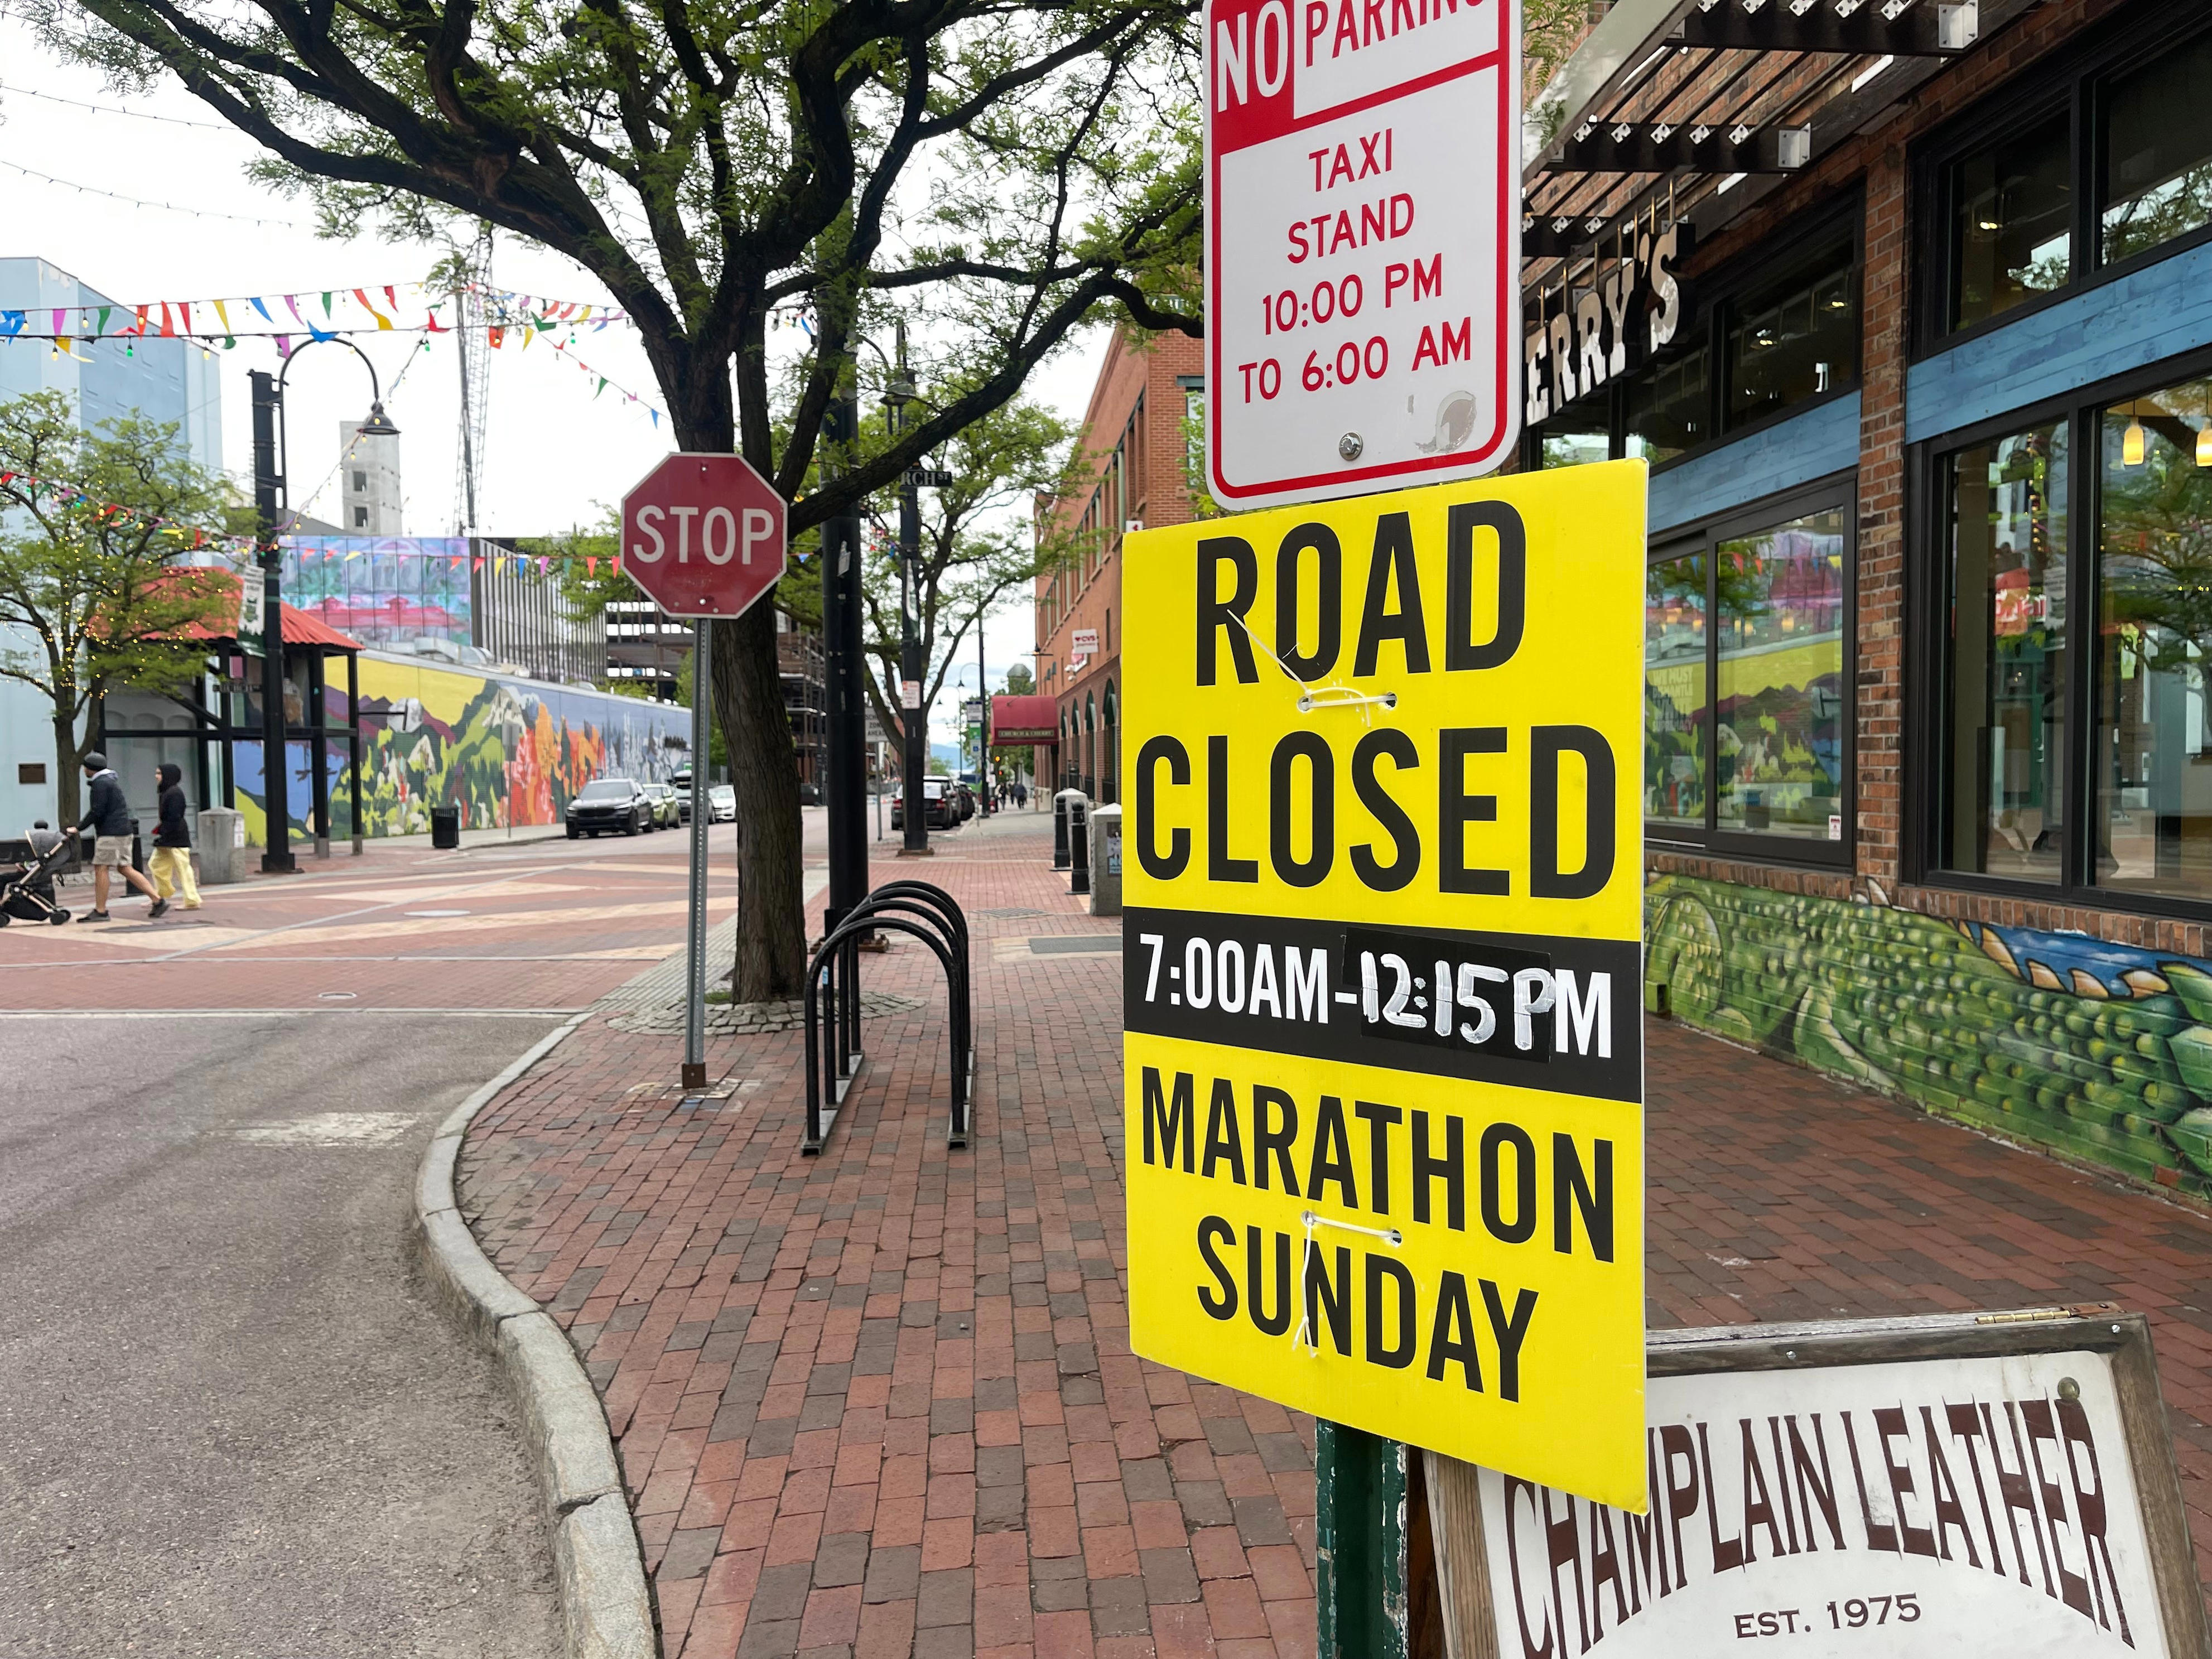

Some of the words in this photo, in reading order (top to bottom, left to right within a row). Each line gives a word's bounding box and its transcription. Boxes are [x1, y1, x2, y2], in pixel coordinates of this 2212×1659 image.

[1217, 0, 1288, 113] NO
[1306, 0, 1484, 67] PARK
[1309, 128, 1393, 192] TAXI
[1288, 192, 1414, 264] STAND
[1262, 273, 1363, 335] 10:00
[1385, 253, 1442, 308] PM
[1526, 223, 1680, 427] ERRY'S
[1238, 362, 1282, 404] TO
[1302, 335, 1389, 392] 6:00
[1411, 317, 1472, 372] AM
[900, 471, 936, 485] RCH
[633, 504, 774, 566] STOP
[1196, 500, 1526, 687] ROAD
[1136, 725, 1616, 900] CLOSED
[1141, 1066, 1614, 1264] MARATHON
[1197, 1215, 1540, 1403] SUNDAY
[1504, 1413, 1847, 1659] CHAMPLAIN
[1840, 1387, 2136, 1651] LEATHER
[1733, 1608, 1812, 1639] EST.
[1827, 1592, 1921, 1629] 1975
